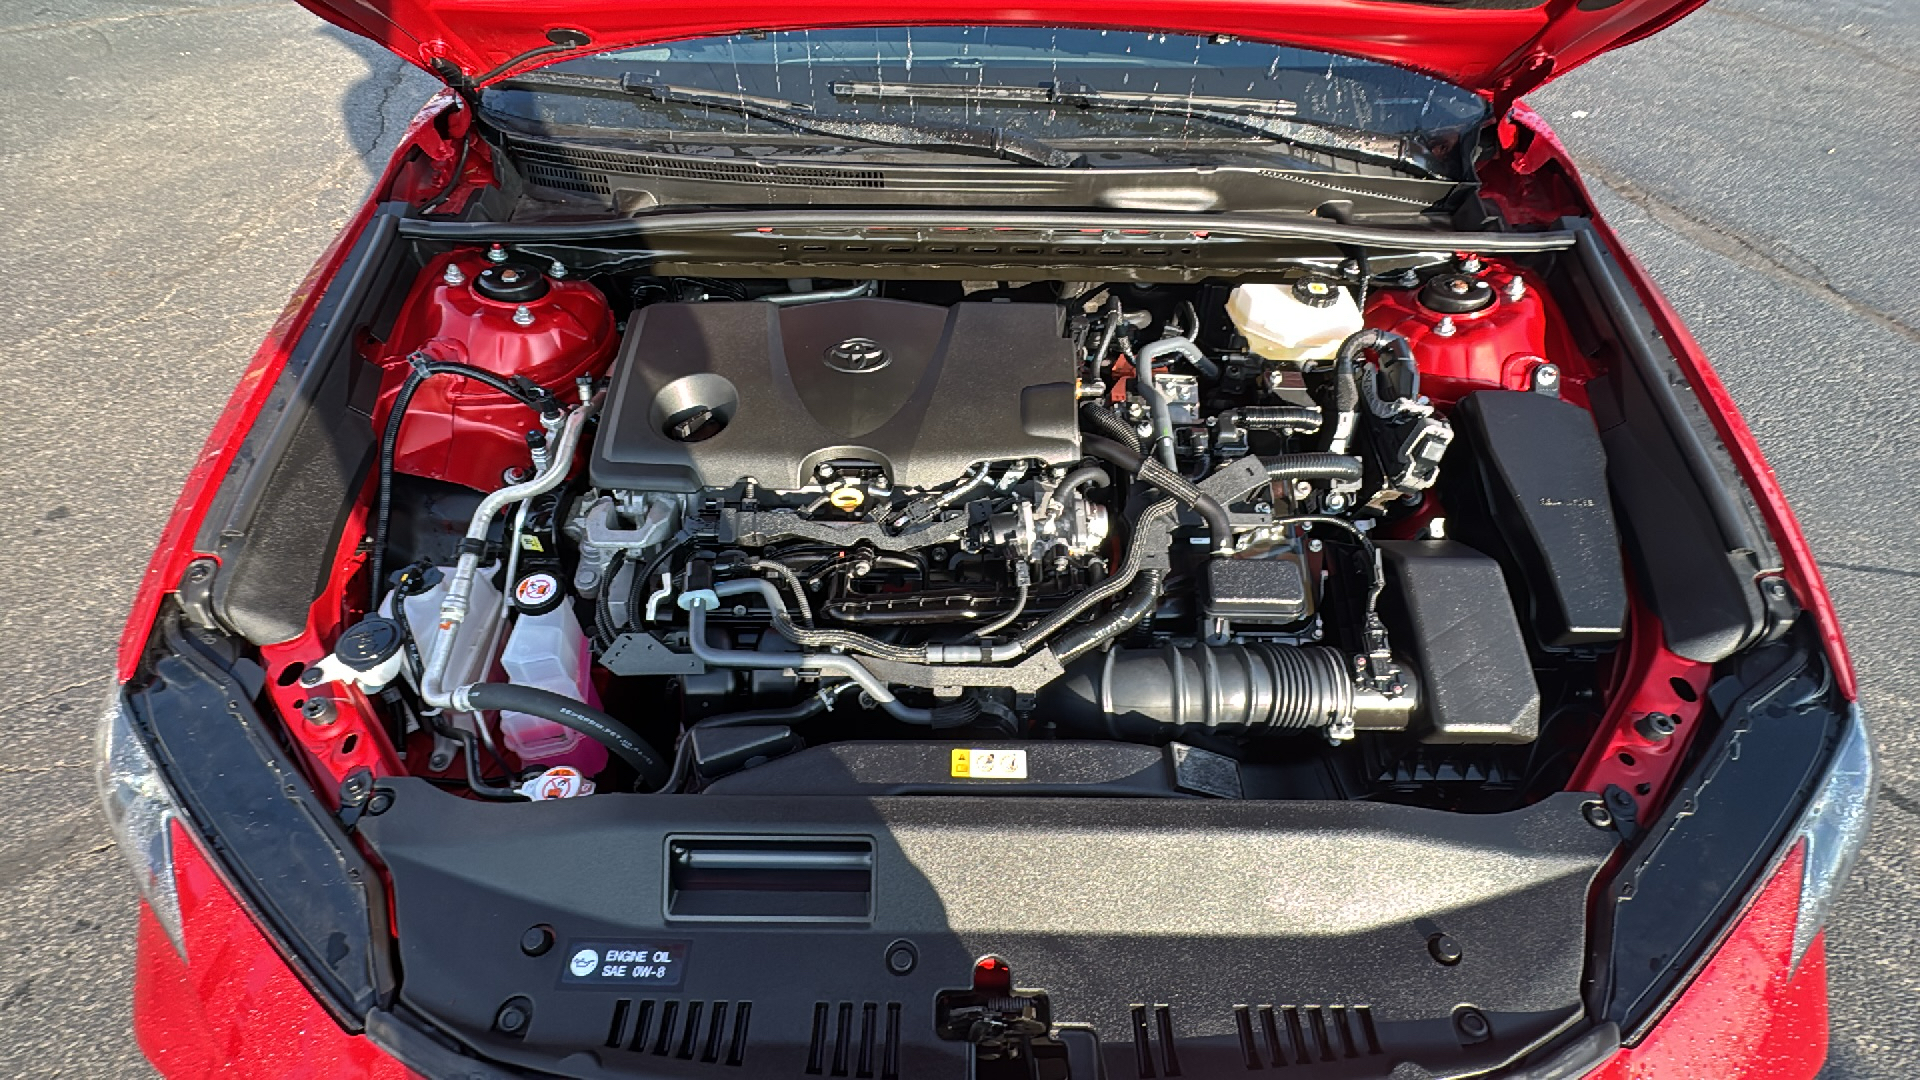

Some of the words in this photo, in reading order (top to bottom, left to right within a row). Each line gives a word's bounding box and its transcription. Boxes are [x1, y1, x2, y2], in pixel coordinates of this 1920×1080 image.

[605, 949, 648, 963] ENGINE
[652, 951, 672, 963] OIL
[602, 965, 626, 977] SAE
[631, 966, 666, 978] 0W-8
